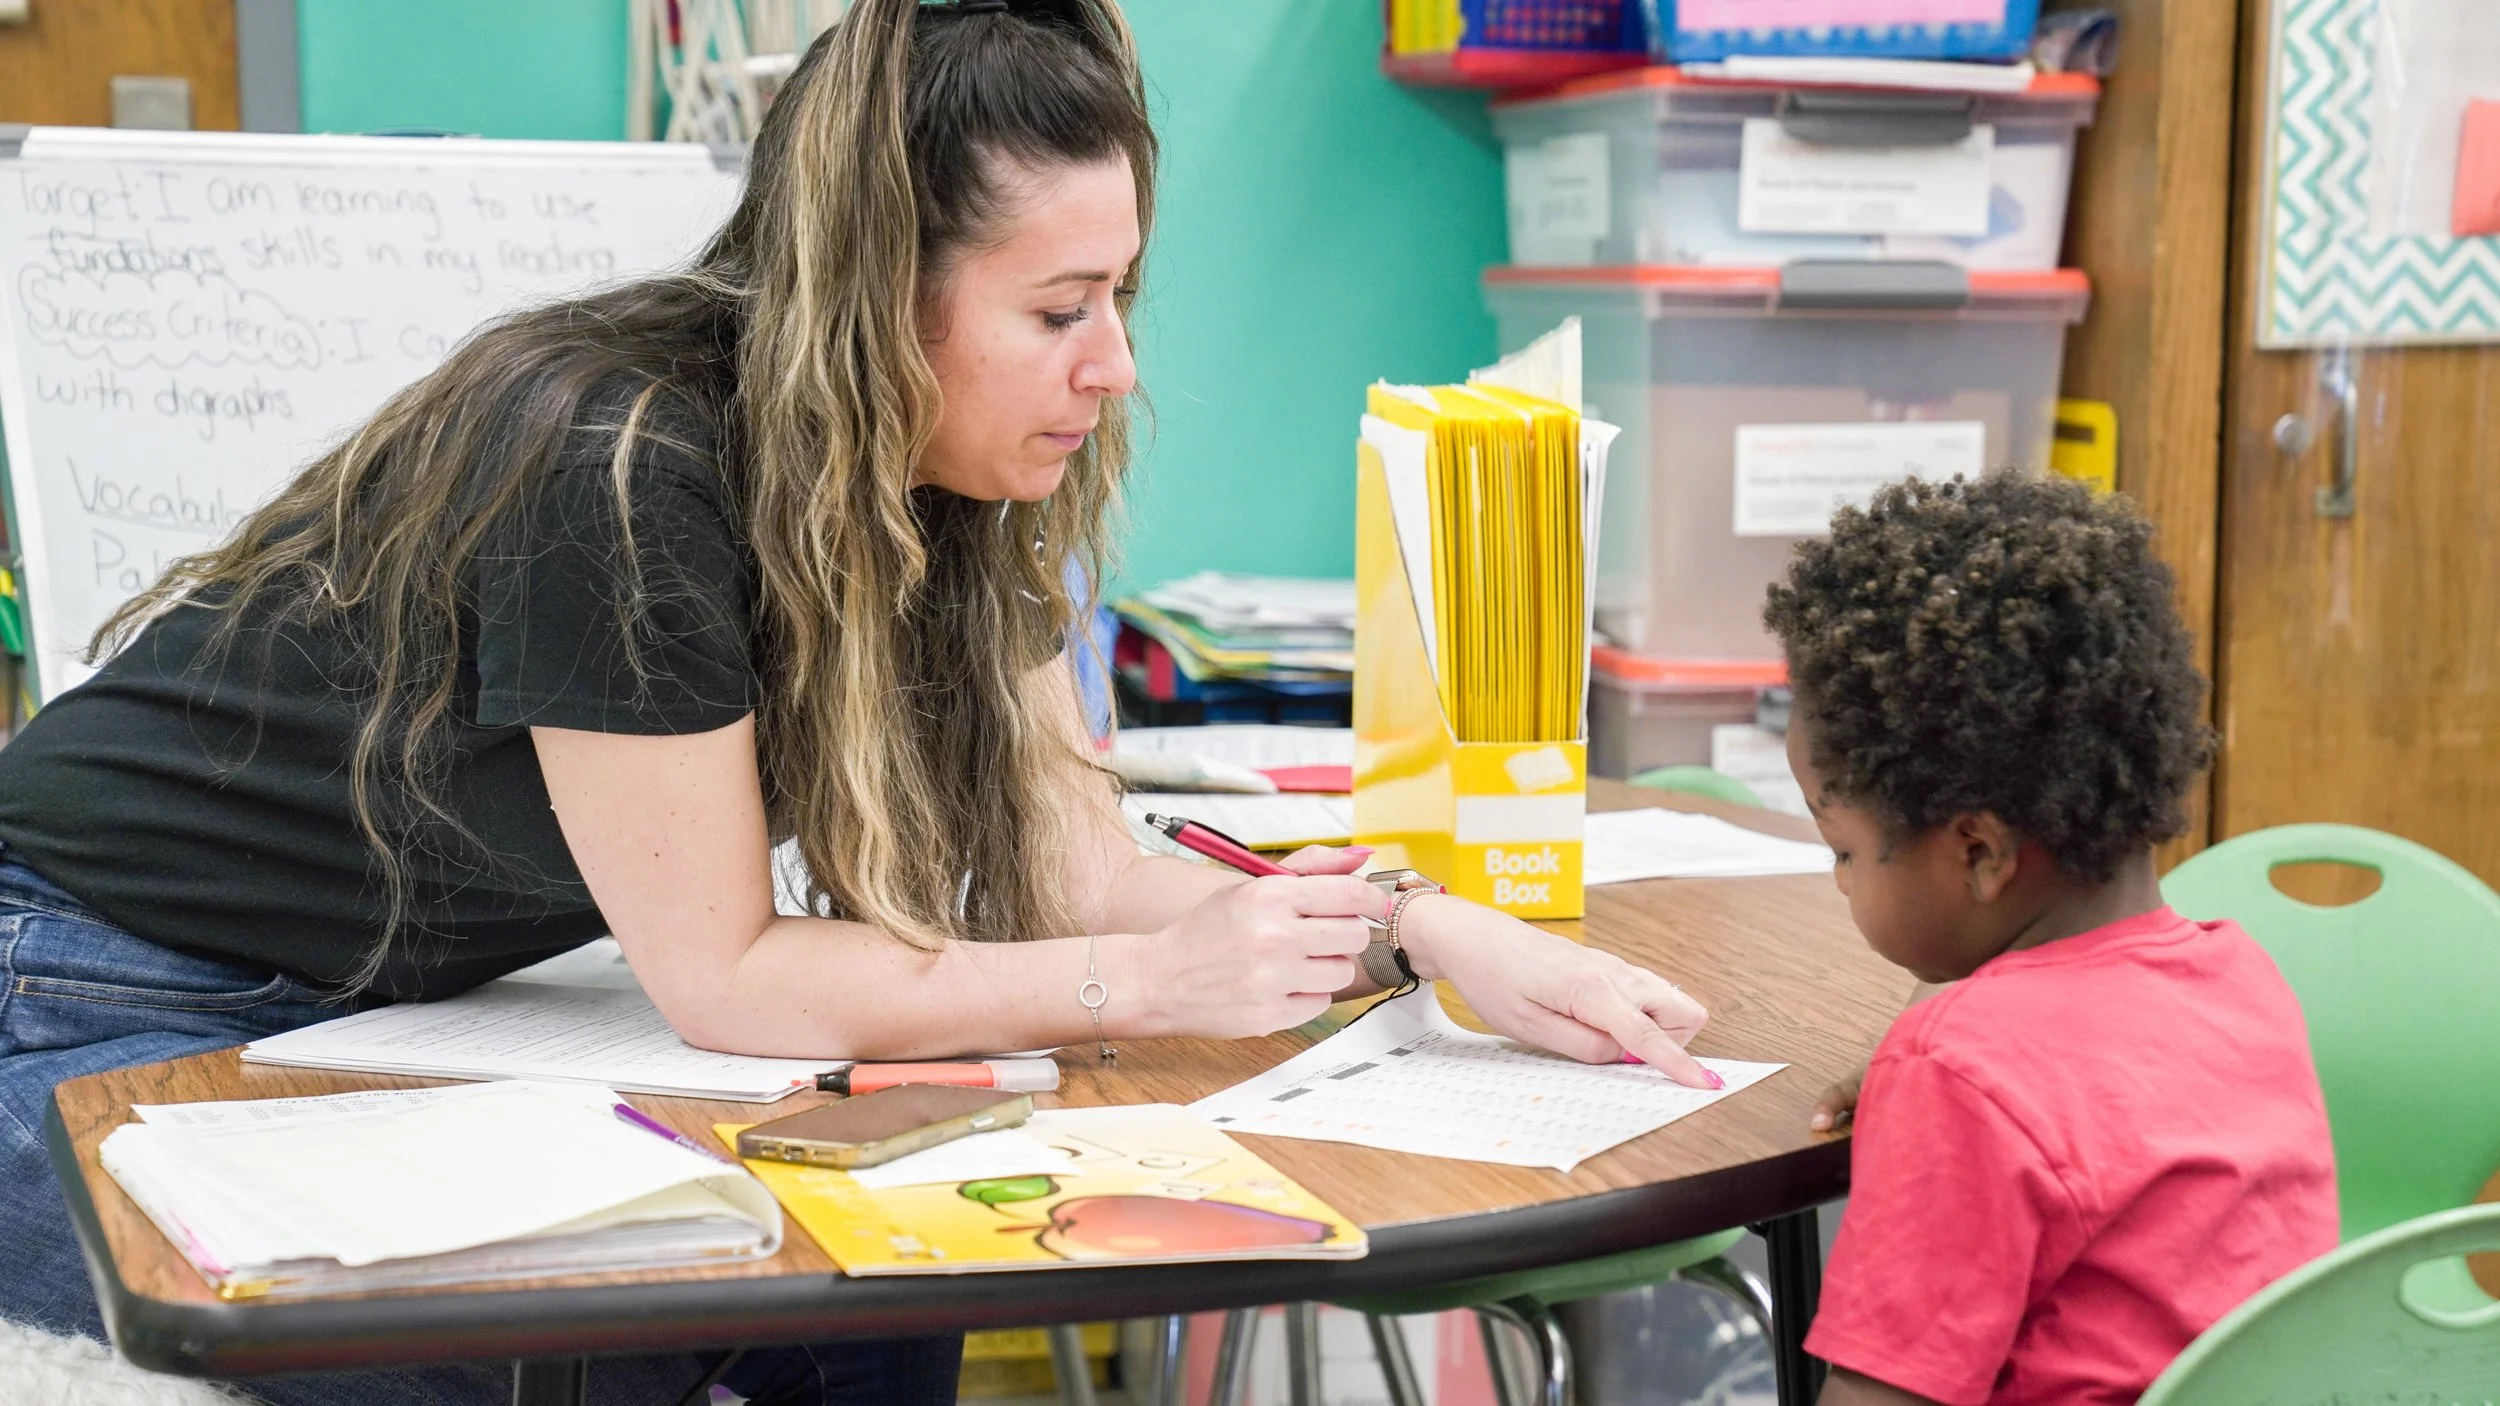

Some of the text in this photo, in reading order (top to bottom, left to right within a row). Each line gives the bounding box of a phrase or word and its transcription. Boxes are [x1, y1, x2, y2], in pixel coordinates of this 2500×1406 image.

[143, 170, 193, 224] I
[206, 175, 277, 216] am
[294, 179, 442, 242] learning
[469, 179, 508, 222] to
[531, 190, 600, 226] use
[241, 226, 343, 271] skills
[364, 240, 404, 270] in
[423, 248, 484, 297] my
[29, 276, 158, 343] Success
[334, 318, 377, 366] I
[36, 367, 294, 443] with digraphs
[1485, 845, 1561, 876] Book
[1494, 877, 1551, 905] Box
